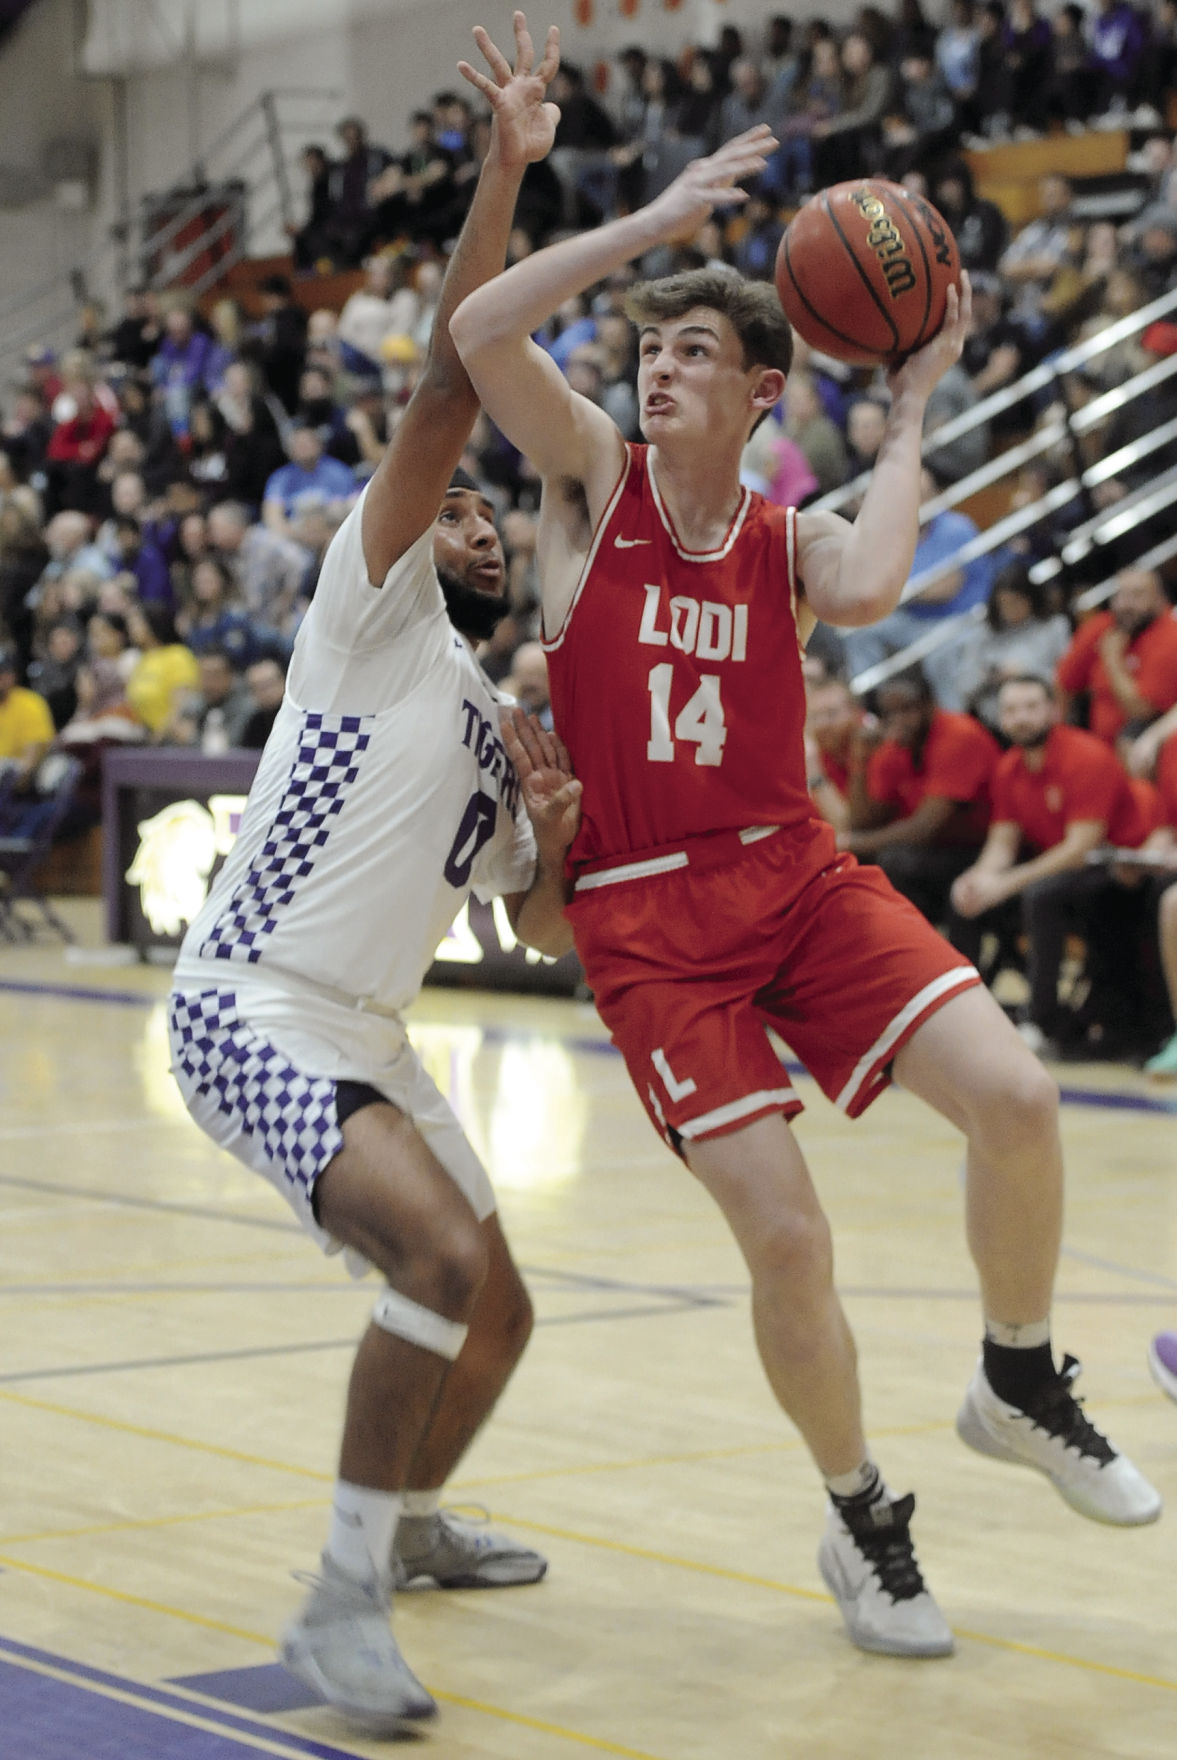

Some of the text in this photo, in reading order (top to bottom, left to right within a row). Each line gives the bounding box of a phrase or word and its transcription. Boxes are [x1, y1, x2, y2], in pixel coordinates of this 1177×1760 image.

[847, 188, 917, 299] Wilson
[638, 583, 749, 662] LODI
[647, 662, 728, 767] 14
[444, 790, 498, 888] 0
[651, 1047, 698, 1103] L
